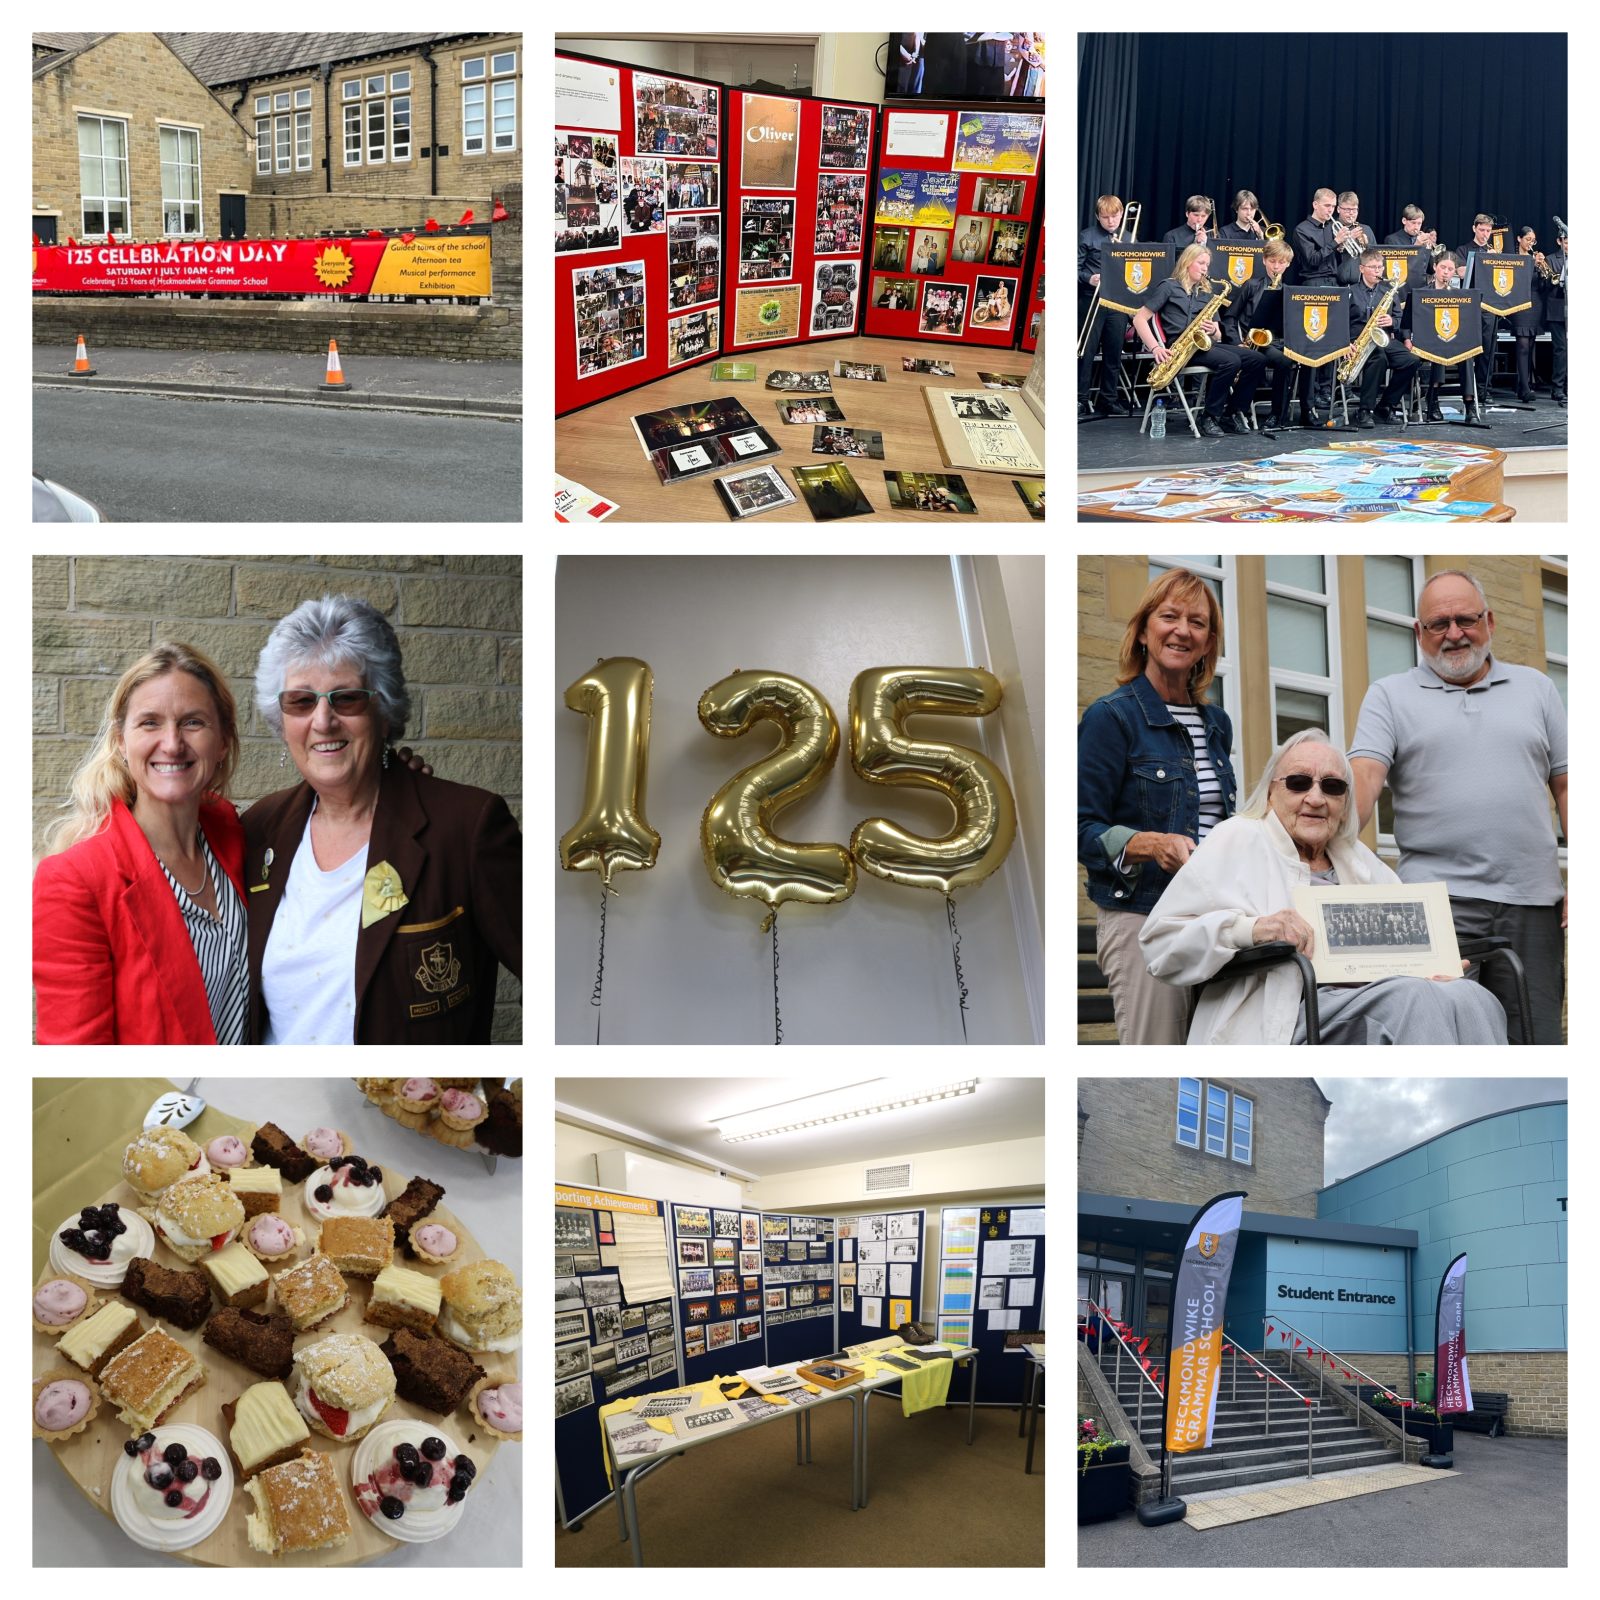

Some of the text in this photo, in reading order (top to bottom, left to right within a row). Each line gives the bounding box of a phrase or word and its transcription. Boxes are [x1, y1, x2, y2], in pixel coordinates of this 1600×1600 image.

[746, 126, 794, 143] Oliver
[68, 249, 93, 265] 125
[240, 244, 287, 263] DAY
[391, 243, 416, 252] Guided
[437, 243, 445, 254] of
[447, 243, 459, 251] the
[461, 242, 486, 250] school
[1216, 245, 1264, 253] HECKMONDWIK
[411, 256, 447, 265] Afternoon
[106, 267, 152, 276] SATURDAY
[160, 267, 181, 277] JULY
[184, 266, 208, 275] 10AM
[215, 266, 235, 275] 4PM
[399, 269, 476, 278] Musical performance
[82, 276, 268, 287] Celebrating 125 Years of Heckmondwike Grammar School
[419, 281, 456, 289] Exhibition
[559, 656, 1017, 906] 125
[594, 1194, 649, 1211] Achievements
[1277, 1284, 1396, 1305] Student Entrance
[1174, 1298, 1200, 1442] HECKMONDWIKE
[1186, 1355, 1210, 1443] GRAMMAR
[1200, 1280, 1216, 1351] SCHOOL
[1445, 1330, 1456, 1408] HECKMONDWIKE
